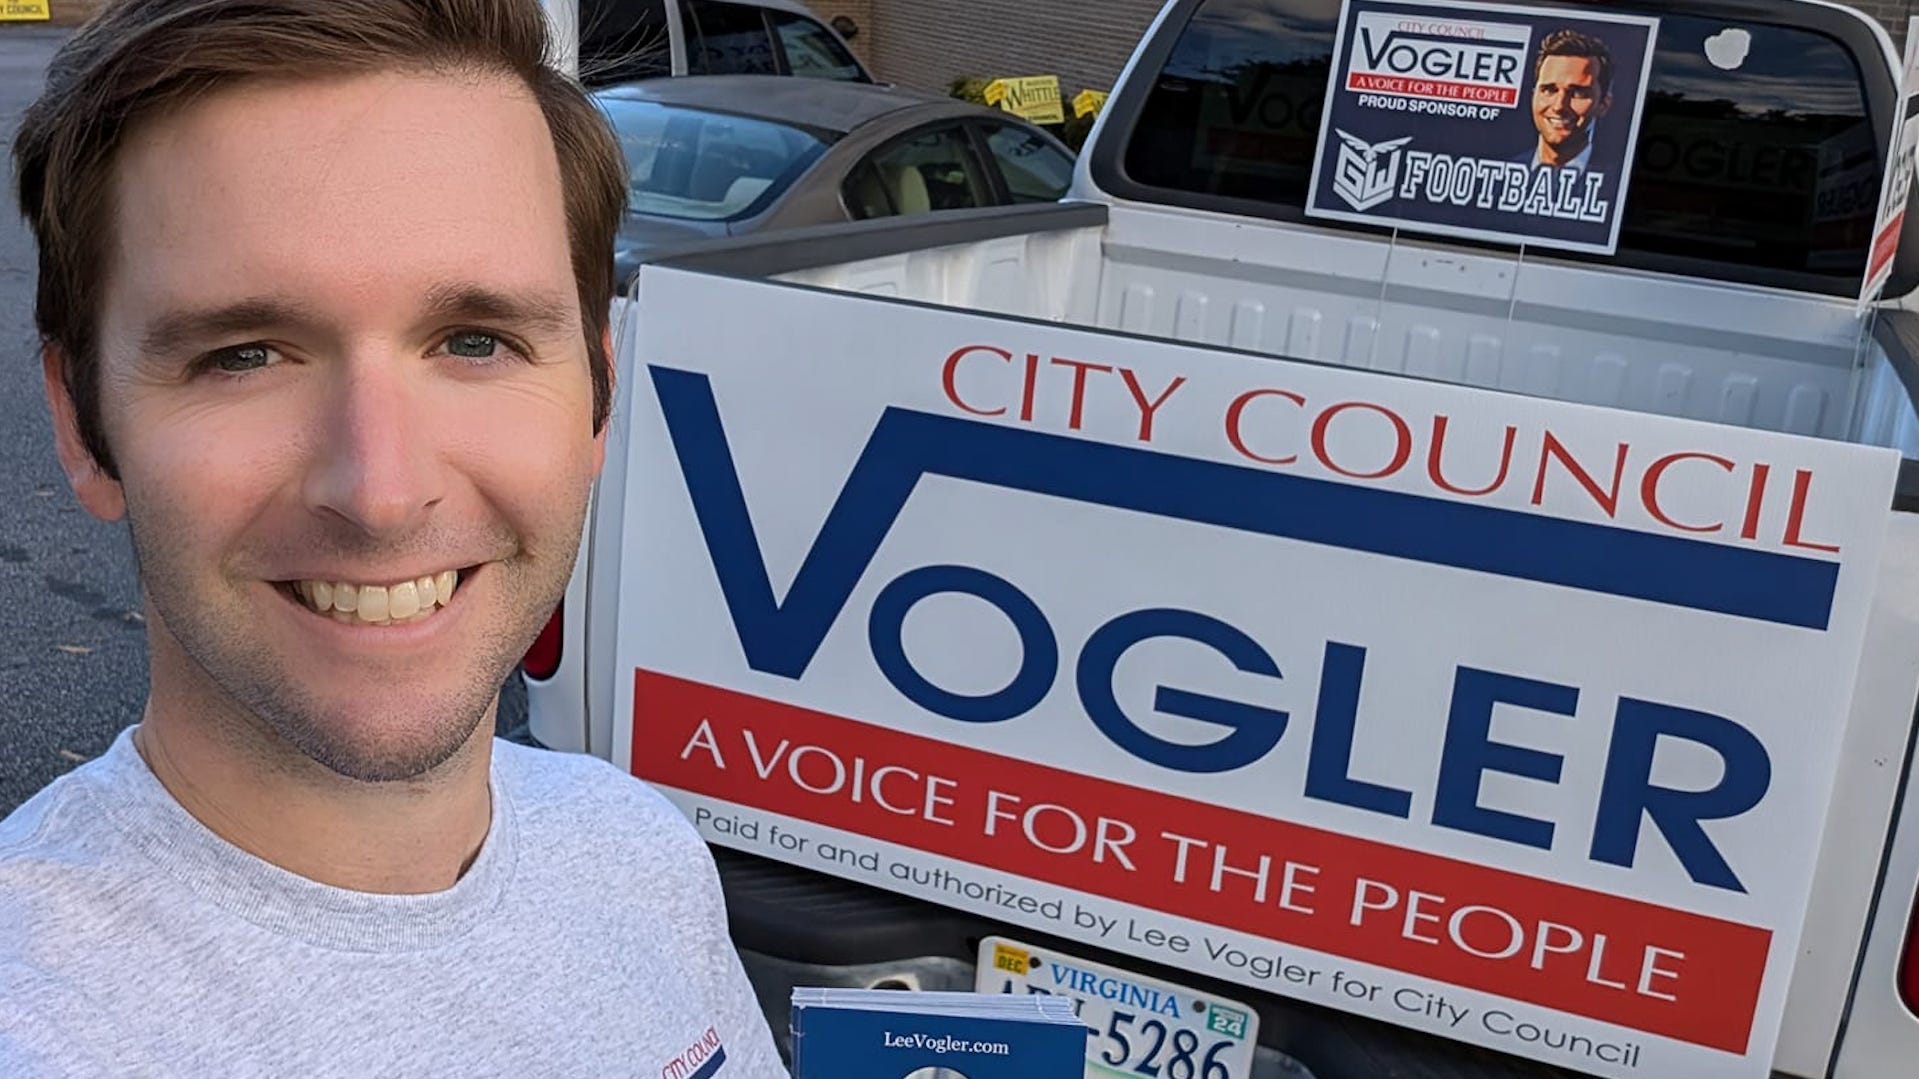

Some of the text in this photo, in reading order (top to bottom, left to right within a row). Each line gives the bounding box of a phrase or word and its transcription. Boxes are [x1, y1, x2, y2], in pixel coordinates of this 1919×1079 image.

[1361, 27, 1525, 84] VOGLER
[1398, 21, 1486, 40] CITY COUNCIL
[1356, 76, 1509, 102] A VOICE FOR THE PEOPLE
[1358, 94, 1500, 121] PROUD SPONSOR OF
[1333, 142, 1609, 224] GW FOOTBALL
[942, 344, 1841, 553] CITY COUNCIL
[647, 364, 1840, 895] VOGLER
[681, 718, 1686, 1003] A VOICE FOR THE PEOPLE
[695, 807, 1641, 1069] Paid for and authorized by Lee Vogler for City Council
[998, 954, 1023, 974] DEC
[1050, 963, 1180, 1019] VIRGINIA
[884, 1031, 1010, 1055] LeeVogler.com
[1213, 1016, 1242, 1036] 24
